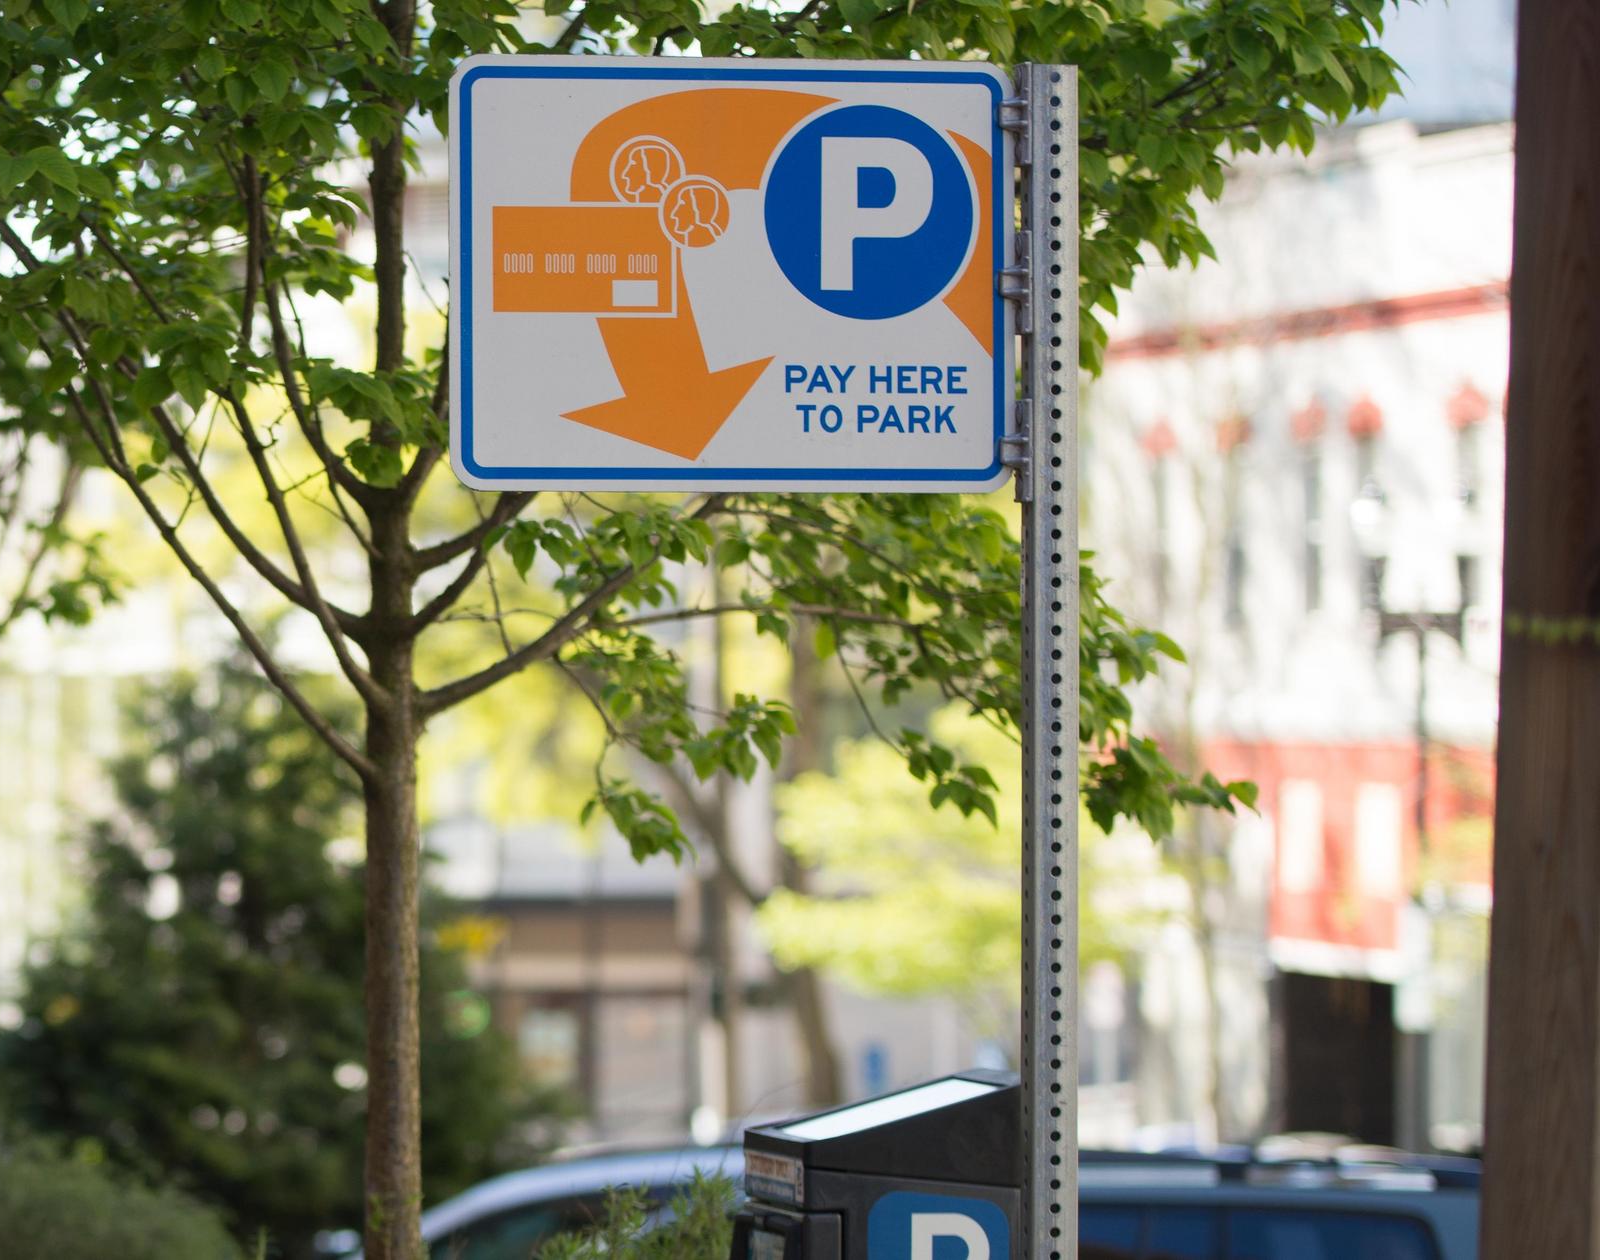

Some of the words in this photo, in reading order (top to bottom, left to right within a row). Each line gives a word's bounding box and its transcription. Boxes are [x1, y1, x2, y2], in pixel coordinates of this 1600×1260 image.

[820, 136, 934, 291] P
[784, 364, 857, 394] PAY
[869, 365, 968, 395] HERE
[795, 404, 844, 434] TO
[856, 404, 958, 434] PARK
